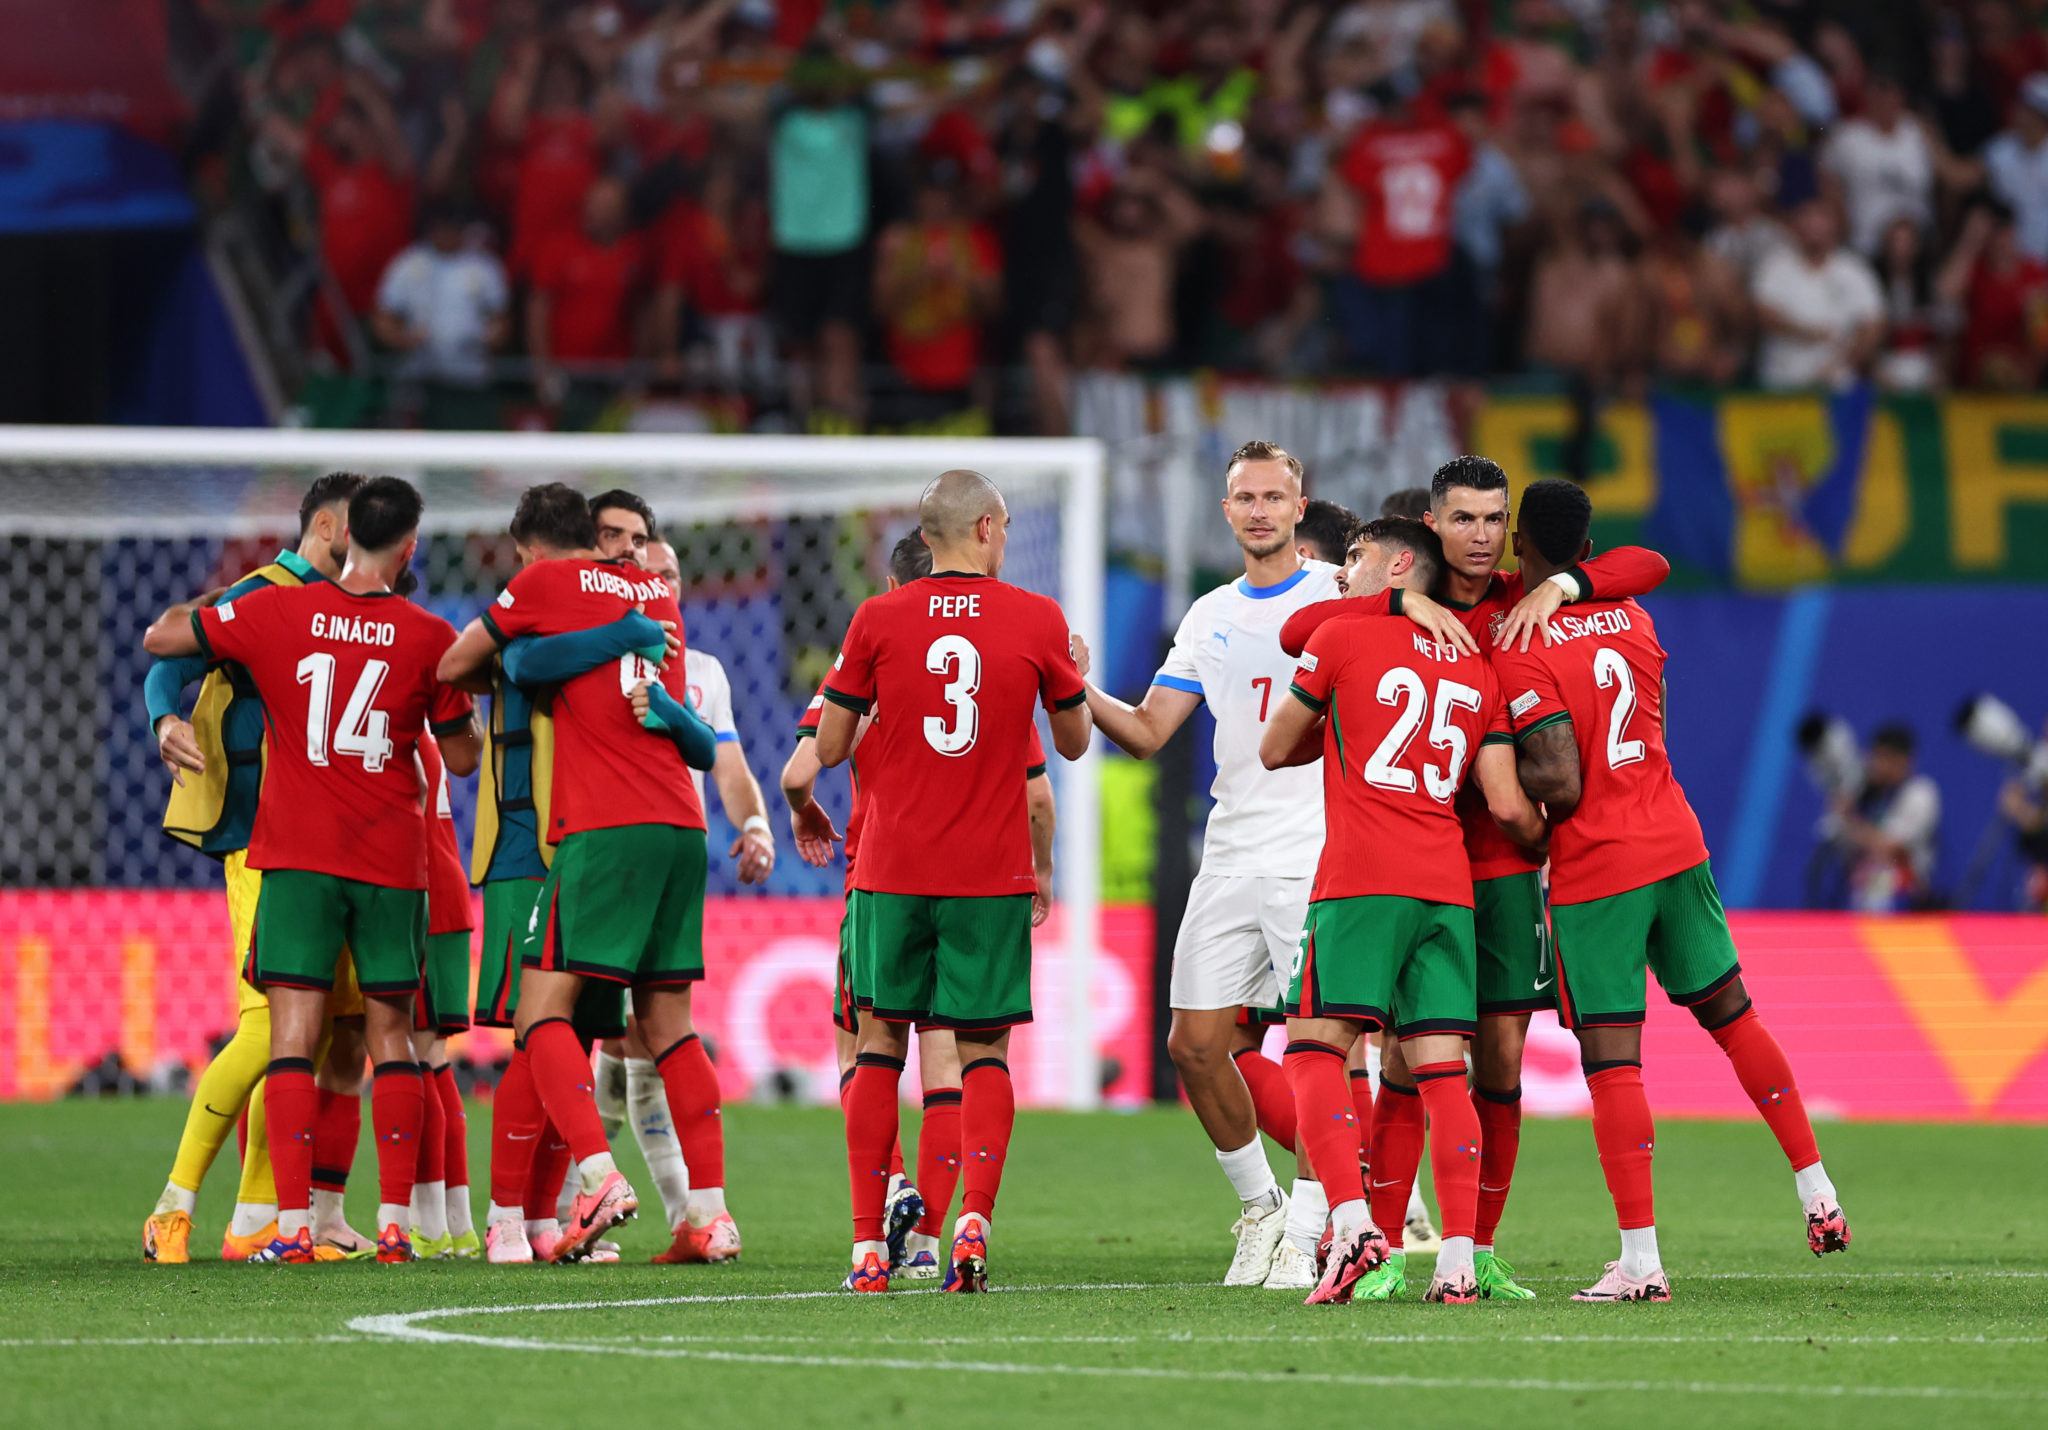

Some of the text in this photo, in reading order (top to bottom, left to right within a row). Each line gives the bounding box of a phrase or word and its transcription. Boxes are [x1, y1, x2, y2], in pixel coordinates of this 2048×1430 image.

[579, 568, 670, 602] RÚBEN DIAS
[928, 594, 981, 618] PEPE
[311, 612, 395, 646] G.INÁCIO
[1413, 632, 1458, 663] NETO
[1548, 608, 1631, 645] N.SEMEDO
[296, 652, 394, 773] 14
[923, 634, 981, 757] 3
[1252, 677, 1272, 722] 7
[1593, 647, 1646, 770] 2
[1364, 666, 1482, 804] 25
[1535, 924, 1547, 974] 7
